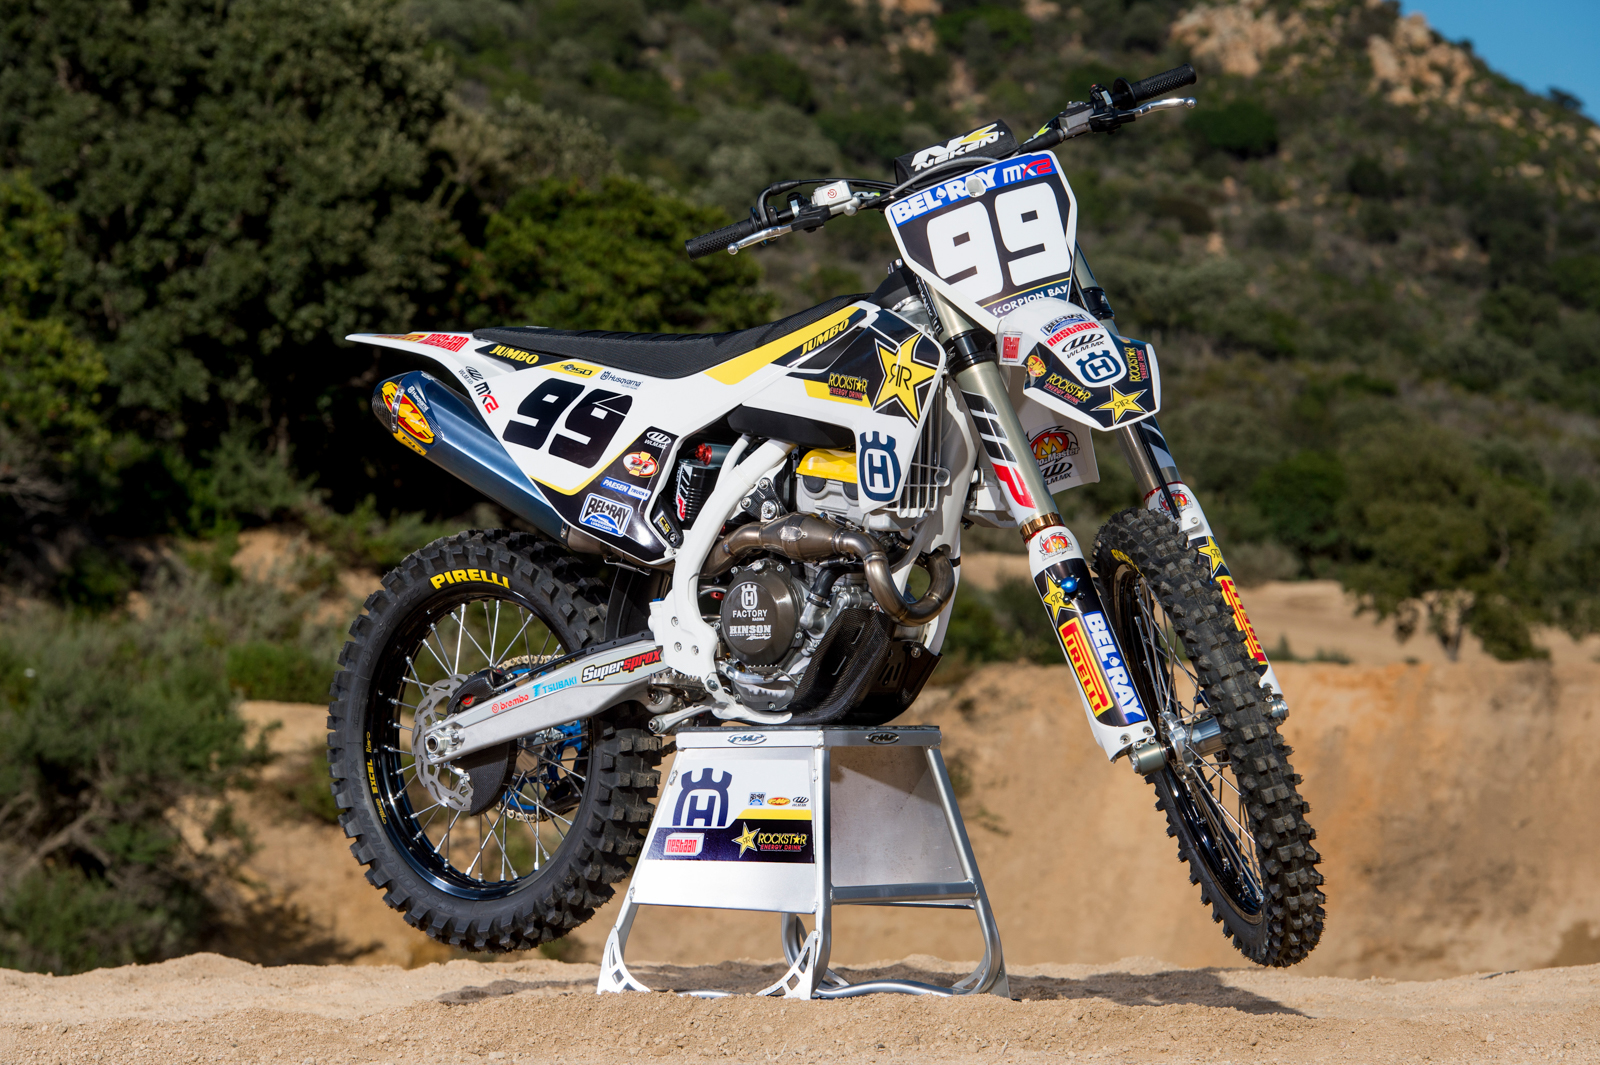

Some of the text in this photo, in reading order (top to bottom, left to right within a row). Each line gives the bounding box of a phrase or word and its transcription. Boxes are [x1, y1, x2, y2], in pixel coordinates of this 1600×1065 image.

[1003, 158, 1053, 183] MX2
[926, 182, 1071, 300] 99
[992, 285, 1069, 316] SCORPION BAY
[800, 318, 850, 356] JUMBO
[489, 345, 540, 365] JUMBO
[608, 372, 643, 388] Husqvarna
[474, 382, 499, 414] MX2
[502, 377, 634, 469] 99
[602, 479, 629, 493] PAESEN
[430, 568, 510, 590] PIRELLI
[732, 609, 768, 618] FACTORY
[729, 624, 772, 634] HINSON
[1061, 621, 1108, 712] PIRELLI
[542, 676, 578, 694] TSUBAKI
[500, 694, 529, 710] brembo
[366, 759, 379, 794] EXCEL
